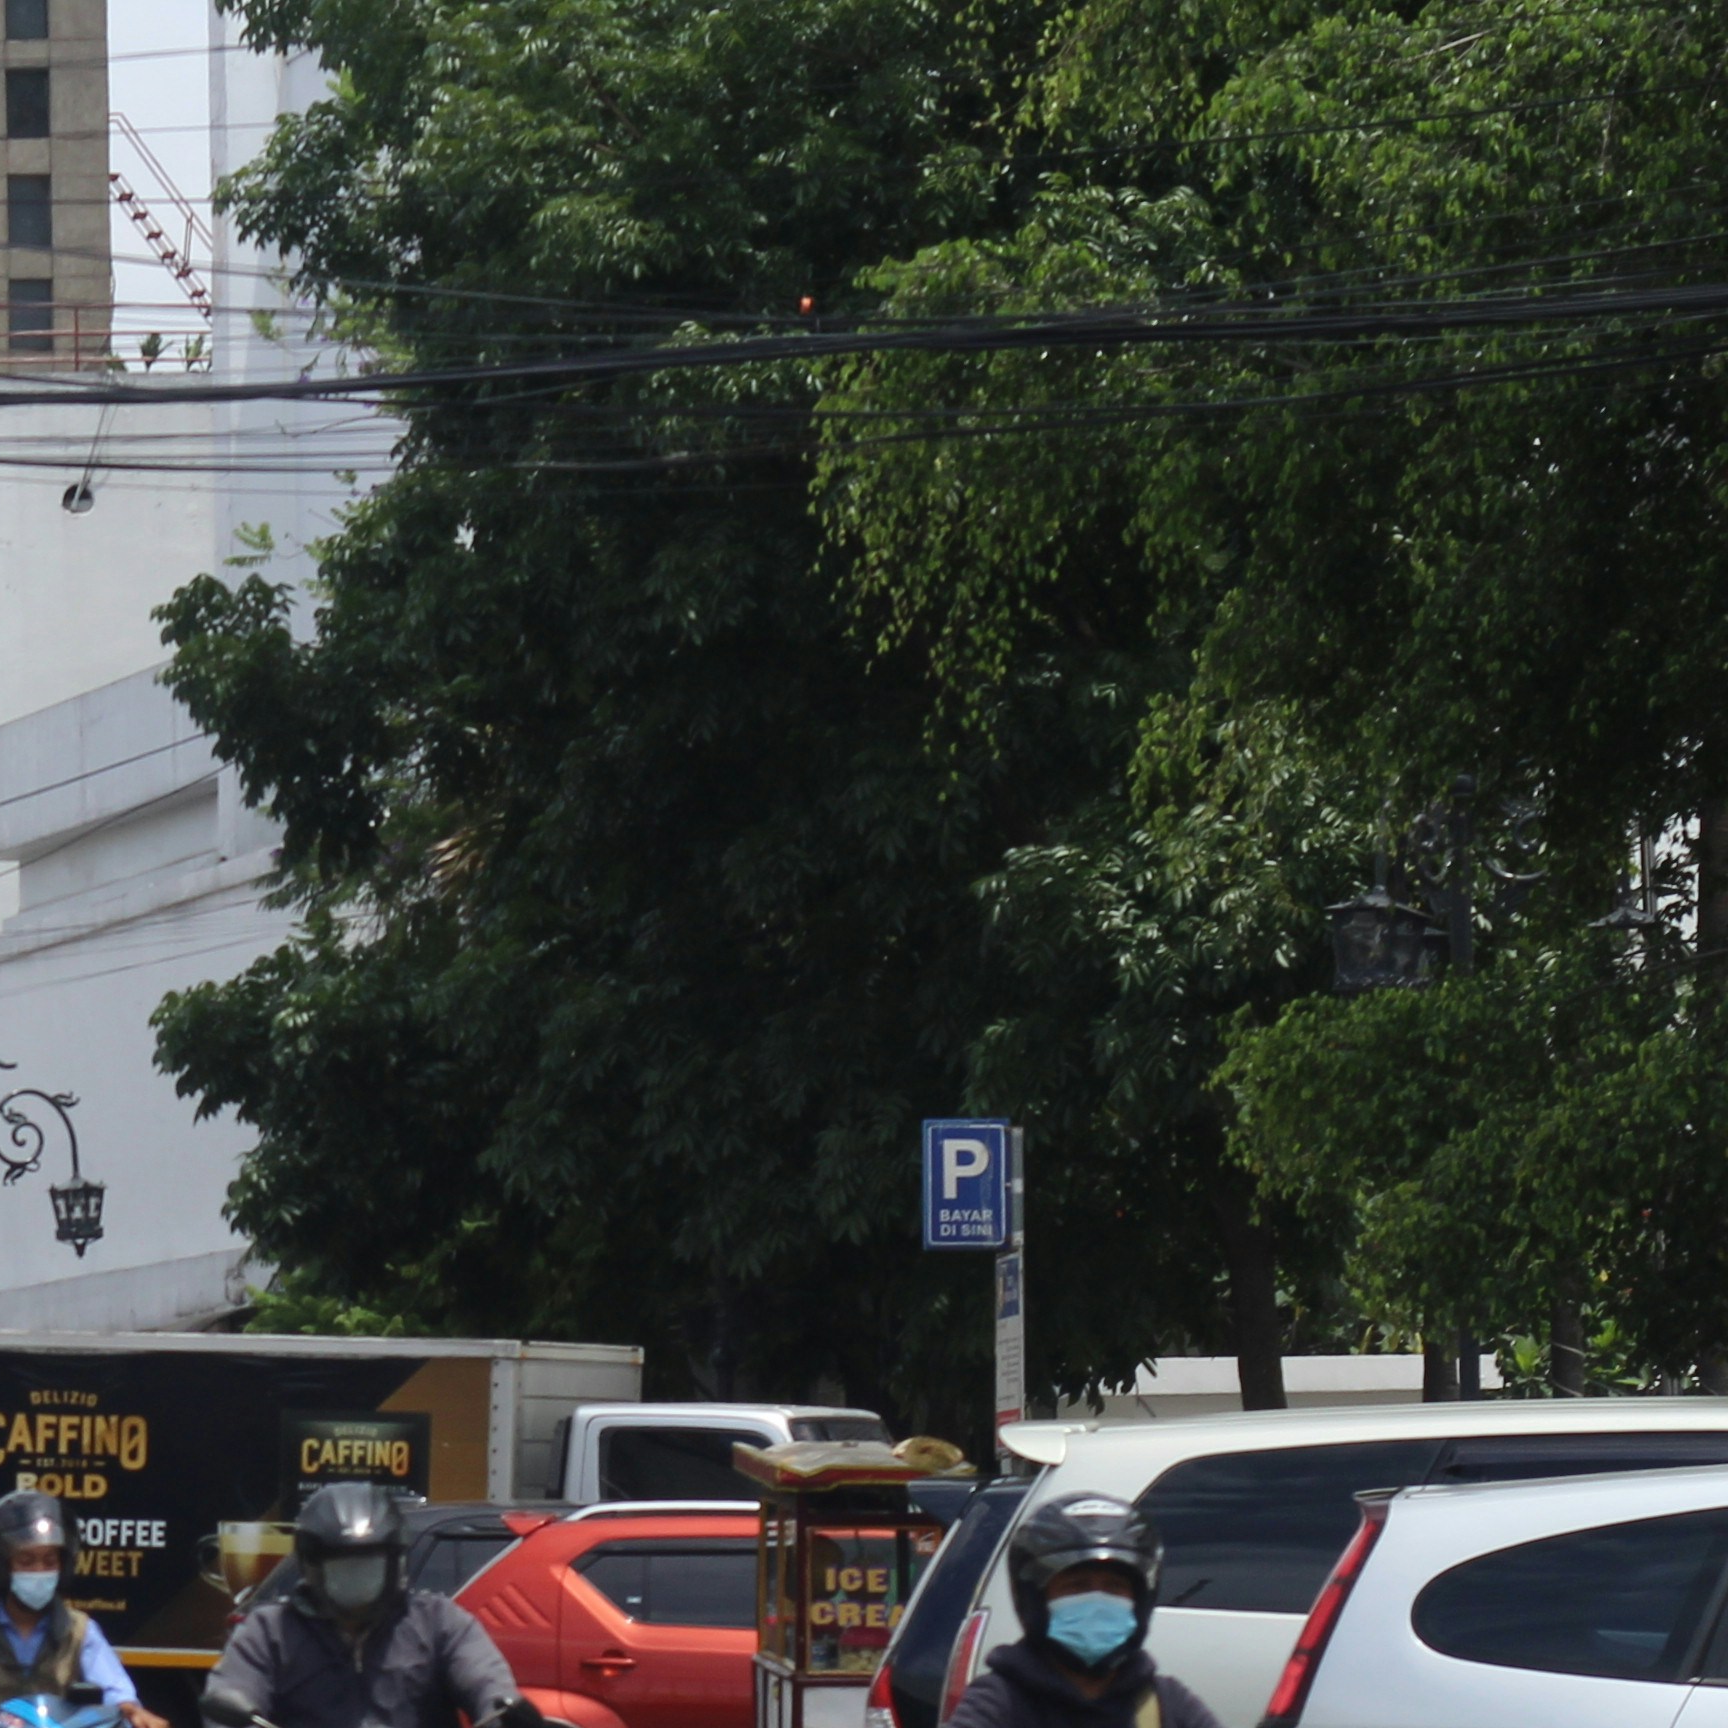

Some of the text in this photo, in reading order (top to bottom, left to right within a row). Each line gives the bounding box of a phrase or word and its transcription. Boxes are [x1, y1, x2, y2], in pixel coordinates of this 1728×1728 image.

[942, 1138, 990, 1200] P
[939, 1208, 993, 1223] BAYAR
[940, 1223, 993, 1237] DI SINI
[30, 1389, 98, 1407] DELIZIO
[301, 1437, 410, 1477] CAFFINO
[16, 1471, 108, 1499] BOLD
[74, 1550, 144, 1578] WEET
[825, 1567, 888, 1593] ICE
[810, 1601, 907, 1628] CREA
